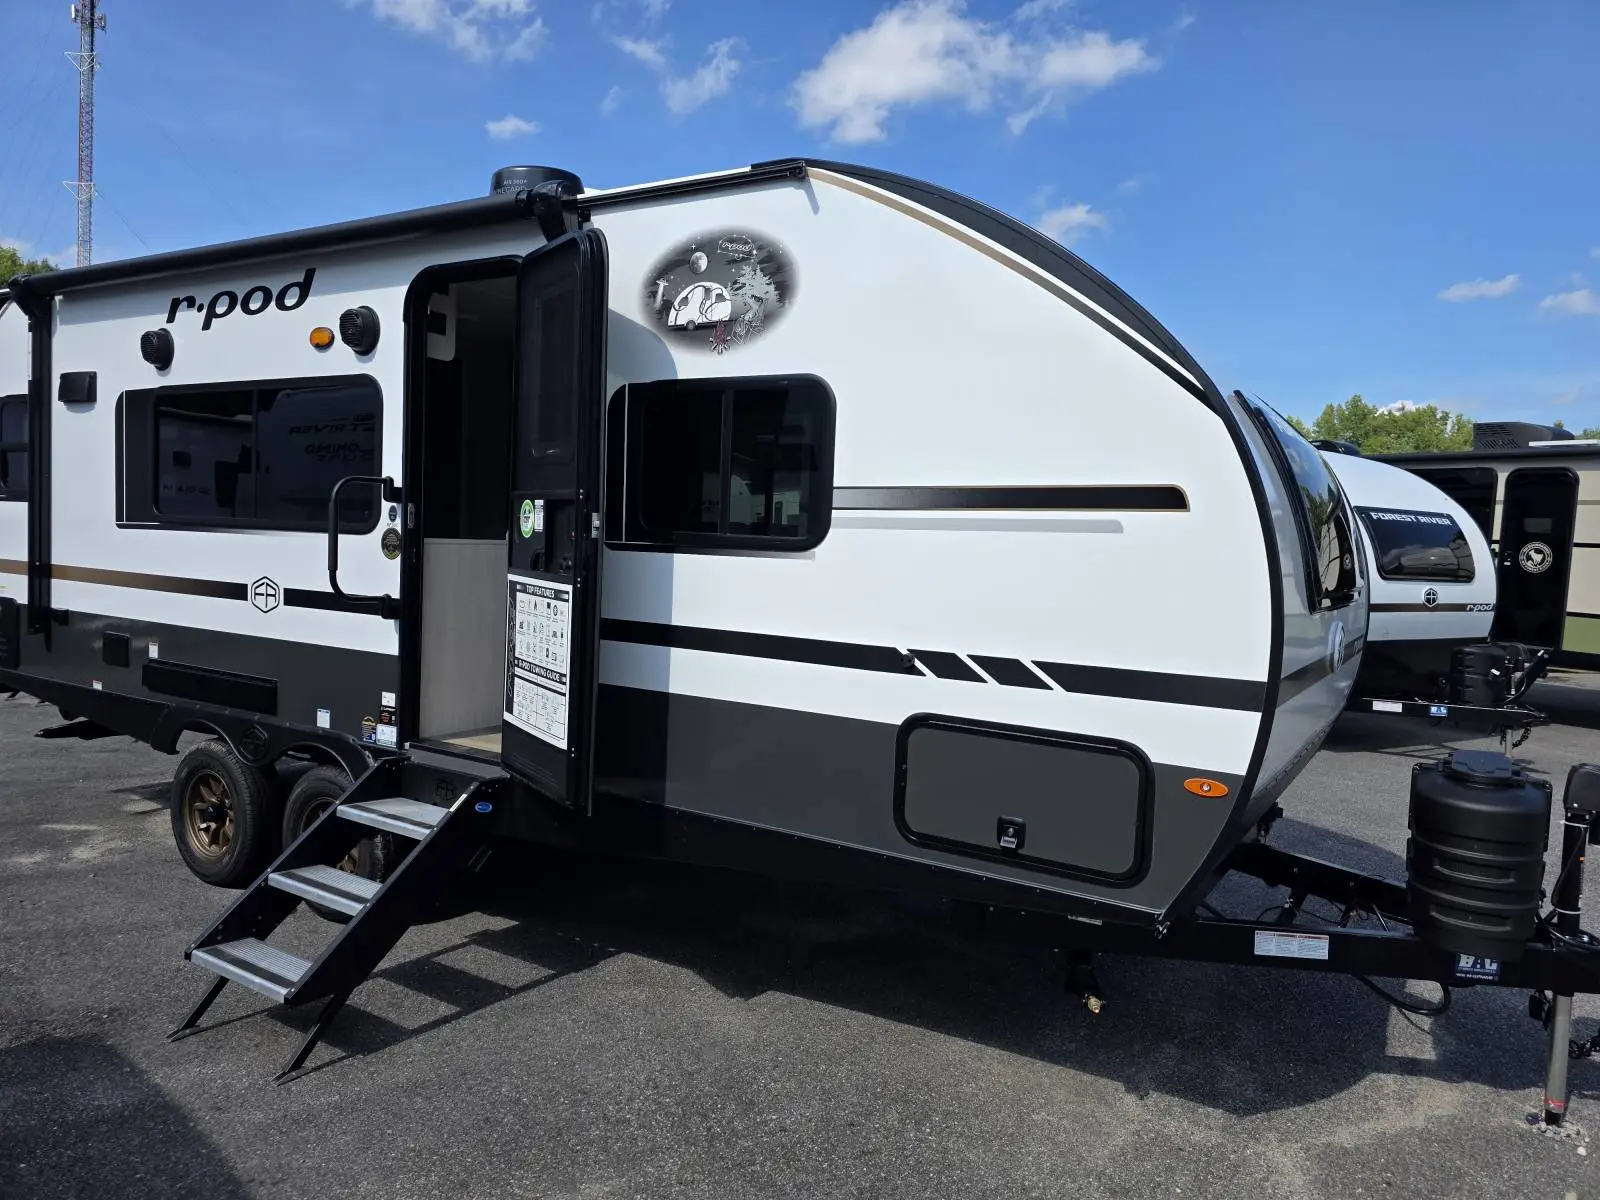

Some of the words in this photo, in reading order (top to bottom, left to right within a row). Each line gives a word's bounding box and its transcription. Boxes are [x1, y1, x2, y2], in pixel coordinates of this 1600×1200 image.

[1369, 511, 1417, 522] FOREST
[1415, 515, 1453, 526] RIVER
[526, 584, 535, 593] TOP
[534, 585, 555, 598] FEATURES
[530, 663, 547, 677] TOWING
[546, 669, 560, 682] GUIDE
